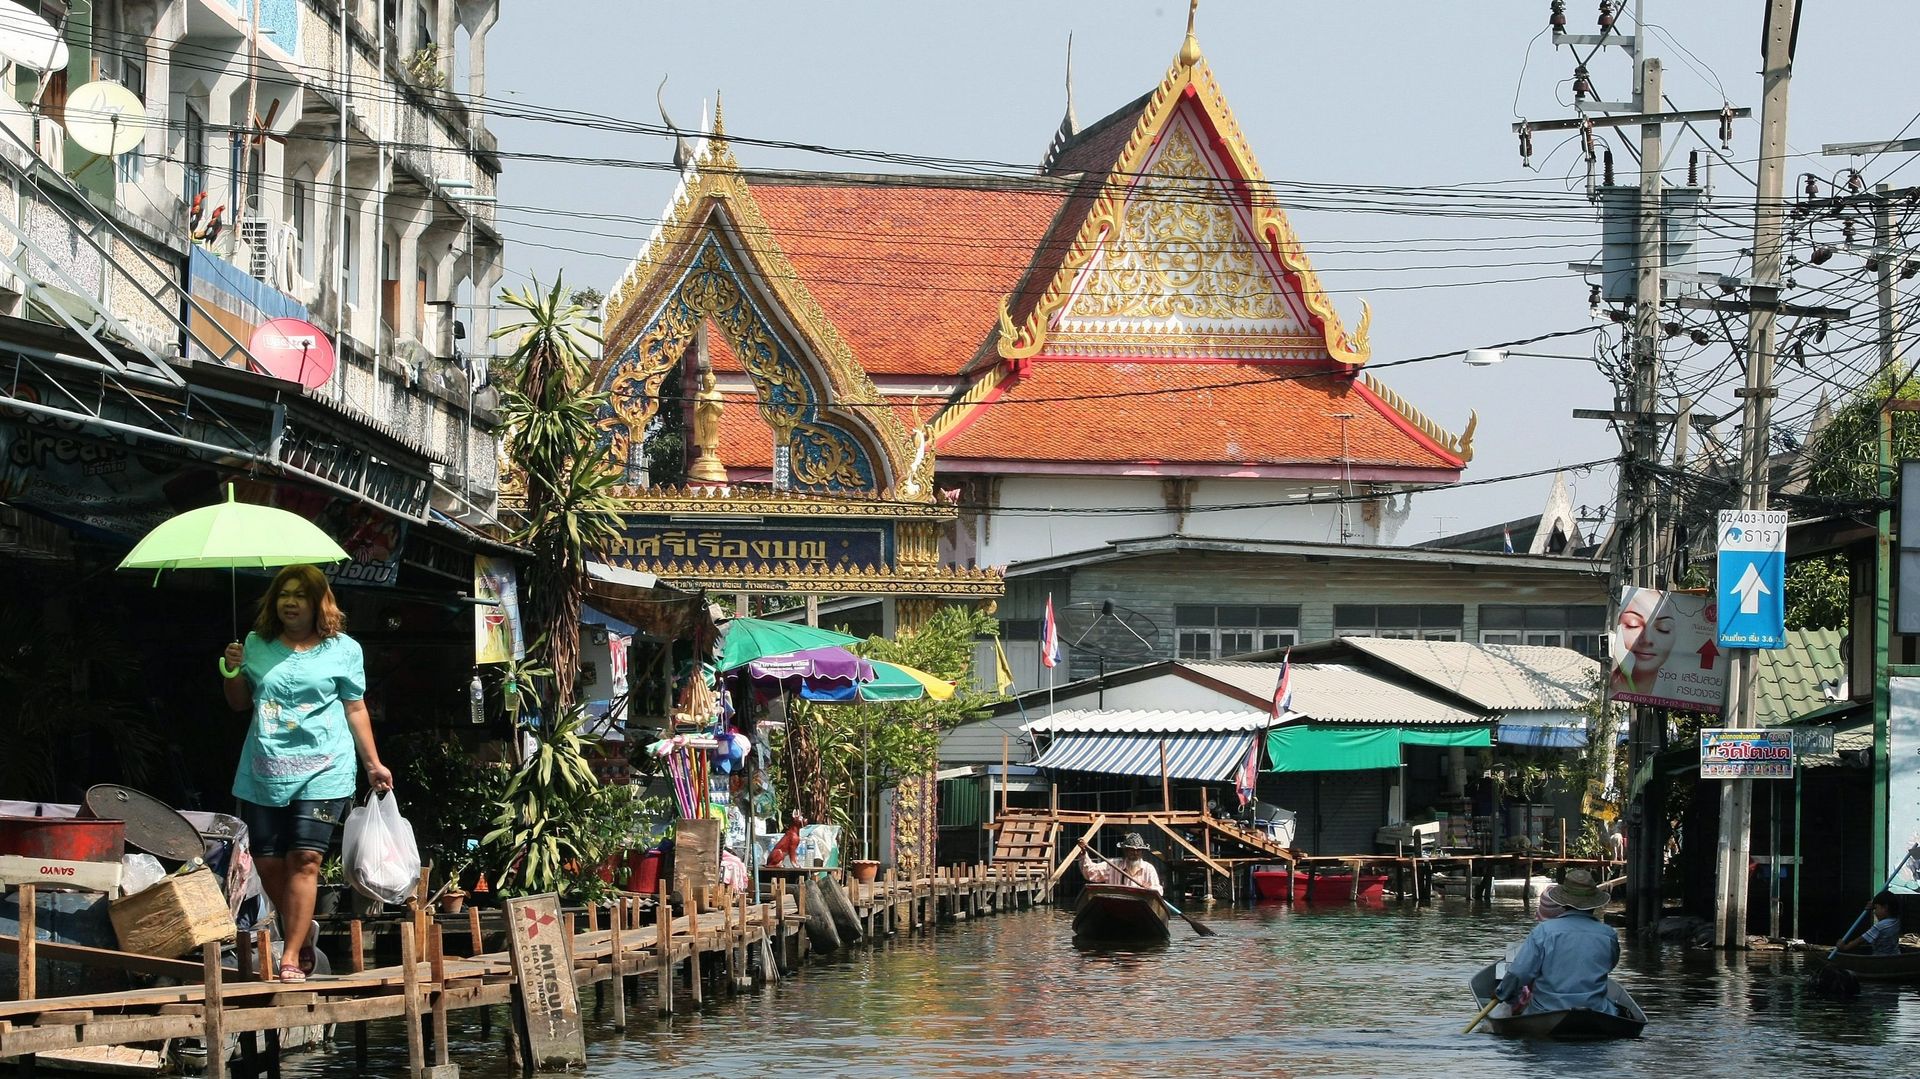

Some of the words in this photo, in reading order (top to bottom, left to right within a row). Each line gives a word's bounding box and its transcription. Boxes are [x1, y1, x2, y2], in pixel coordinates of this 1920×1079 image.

[1720, 513, 1787, 525] 02-403-1000
[1744, 529, 1780, 543] ธารา
[1762, 635, 1773, 643] 3.6
[1658, 668, 1677, 682] Spa
[1718, 742, 1791, 760] วัดโตนด
[40, 866, 75, 876] SANYO
[530, 944, 543, 978] HEAVY
[537, 981, 549, 1016] INDUS
[538, 944, 562, 1022] MITSUB
